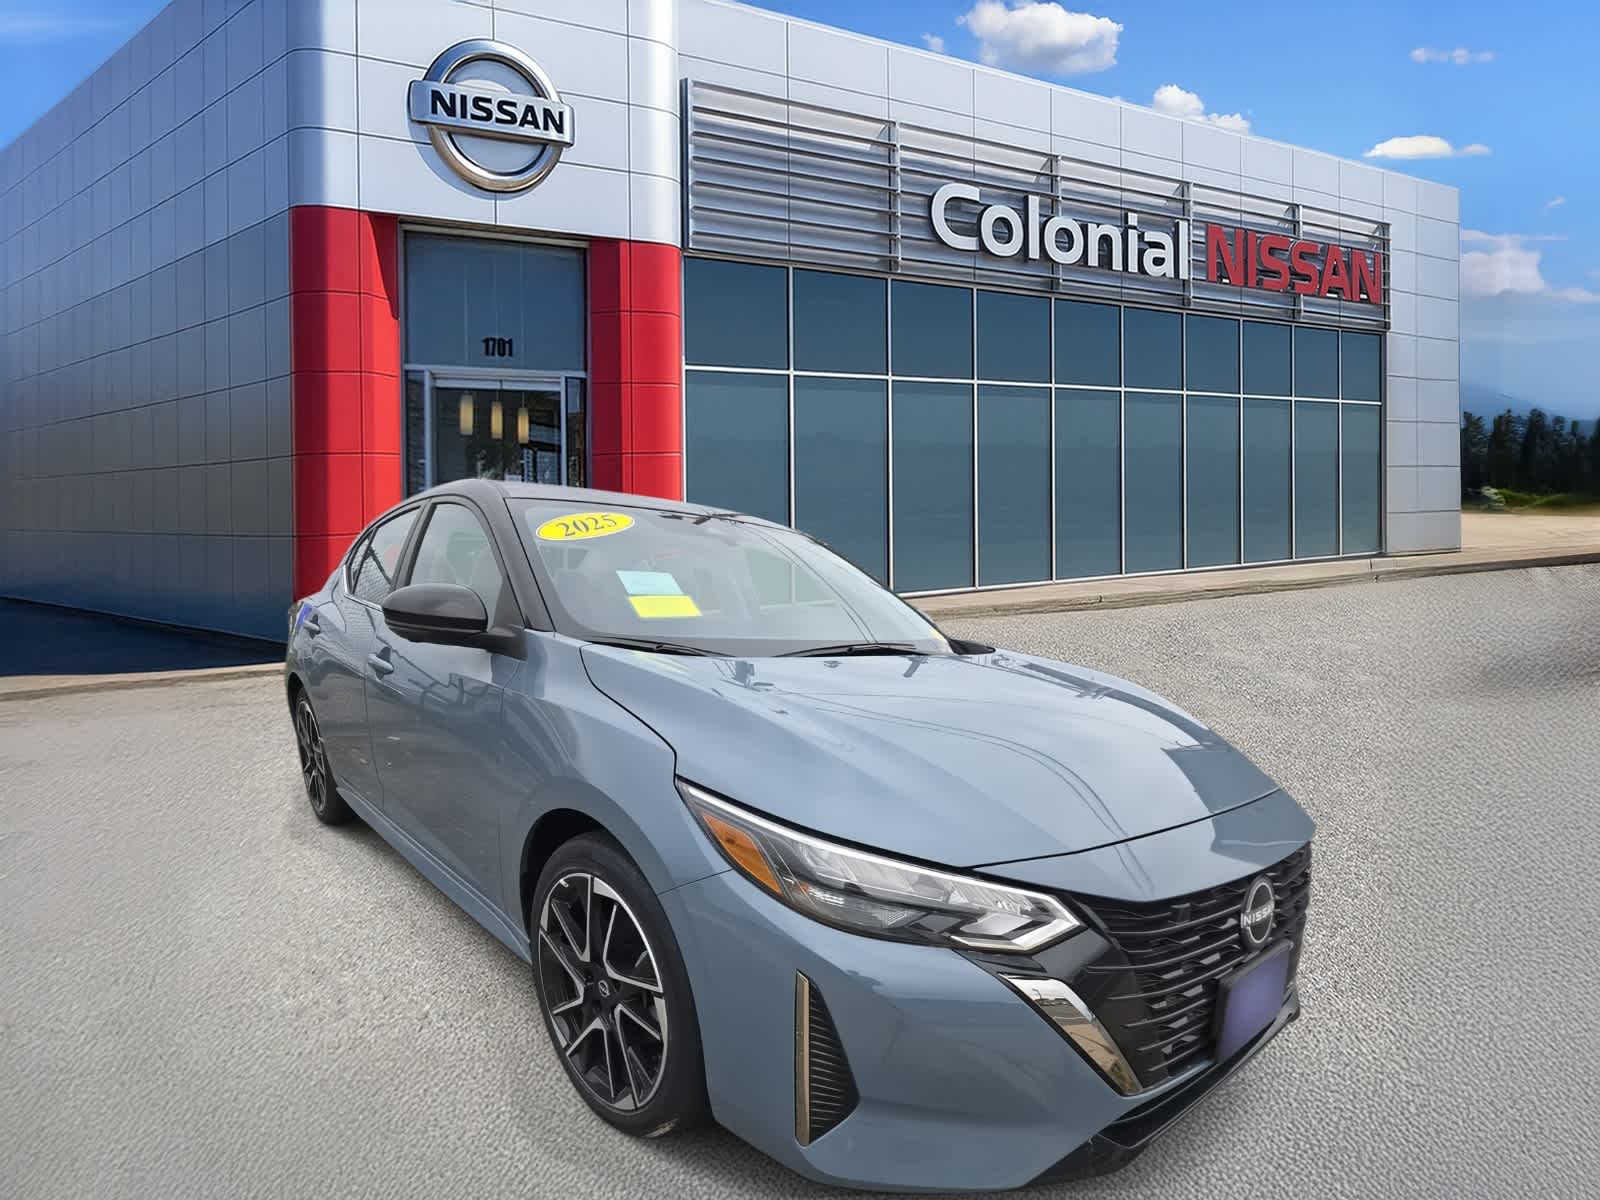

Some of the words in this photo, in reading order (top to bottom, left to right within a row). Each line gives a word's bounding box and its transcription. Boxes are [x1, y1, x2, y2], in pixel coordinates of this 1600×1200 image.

[431, 90, 564, 134] NISSAN
[931, 183, 1188, 279] Colonial
[1206, 224, 1380, 304] NISSAN
[483, 337, 513, 357] 1701
[556, 514, 617, 537] 2025
